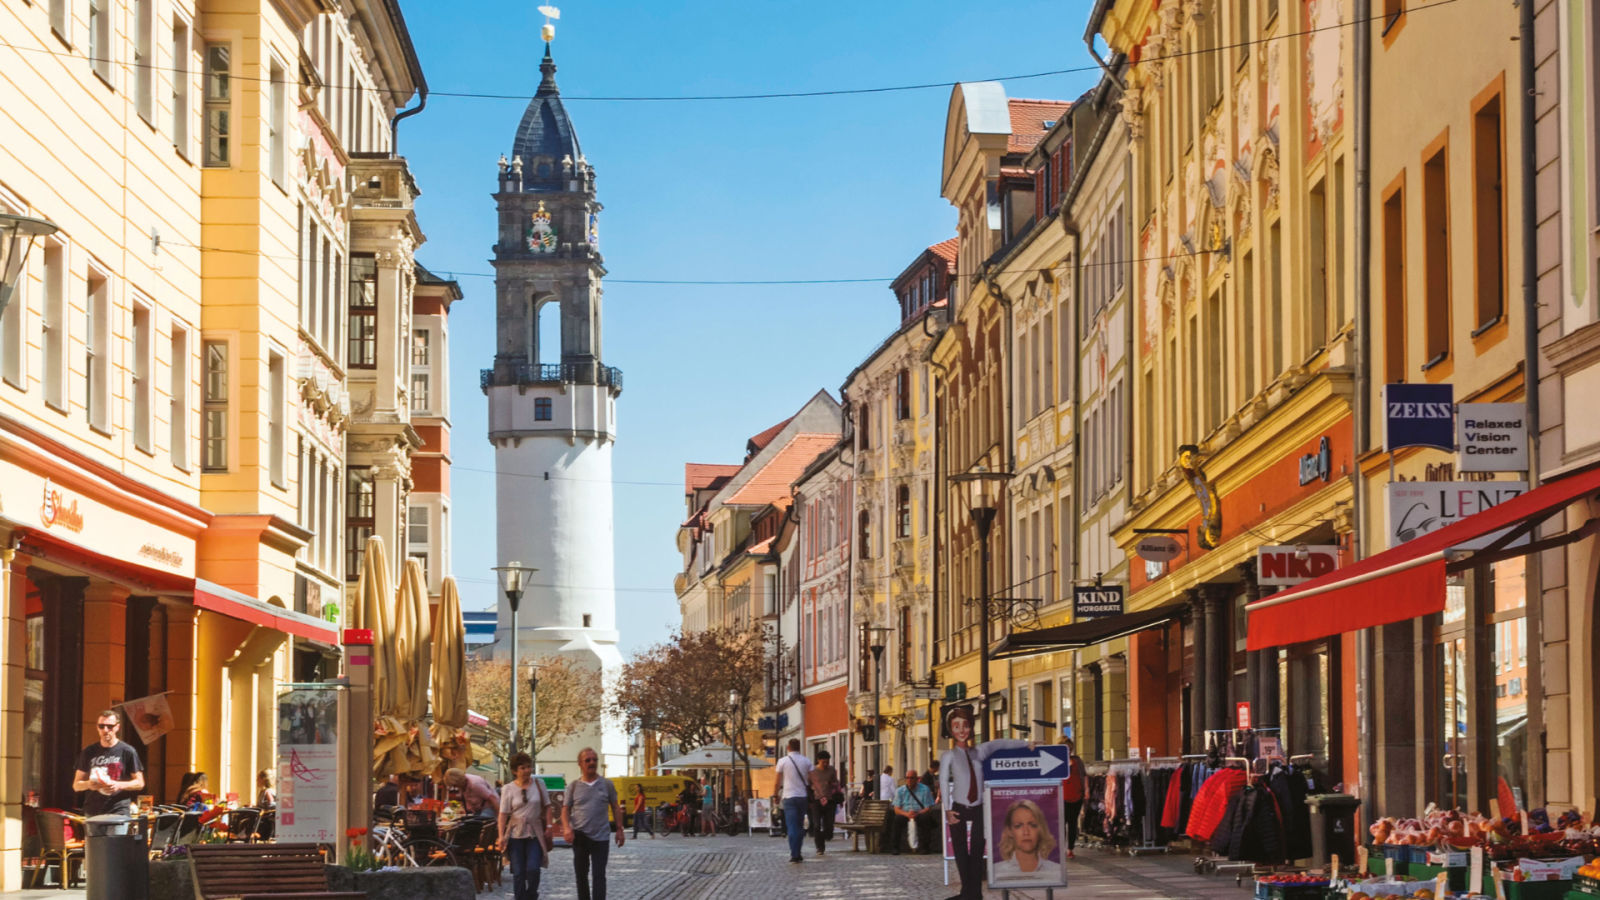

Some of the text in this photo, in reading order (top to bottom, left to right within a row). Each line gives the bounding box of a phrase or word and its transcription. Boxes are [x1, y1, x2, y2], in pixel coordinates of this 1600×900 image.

[1389, 402, 1451, 418] ZEISS
[1465, 419, 1522, 429] Relaxed
[1465, 433, 1511, 441] Vision
[1465, 445, 1518, 455] Center
[1261, 553, 1335, 578] NKD
[1077, 591, 1121, 604] KIND
[995, 759, 1040, 769] Hörtest
